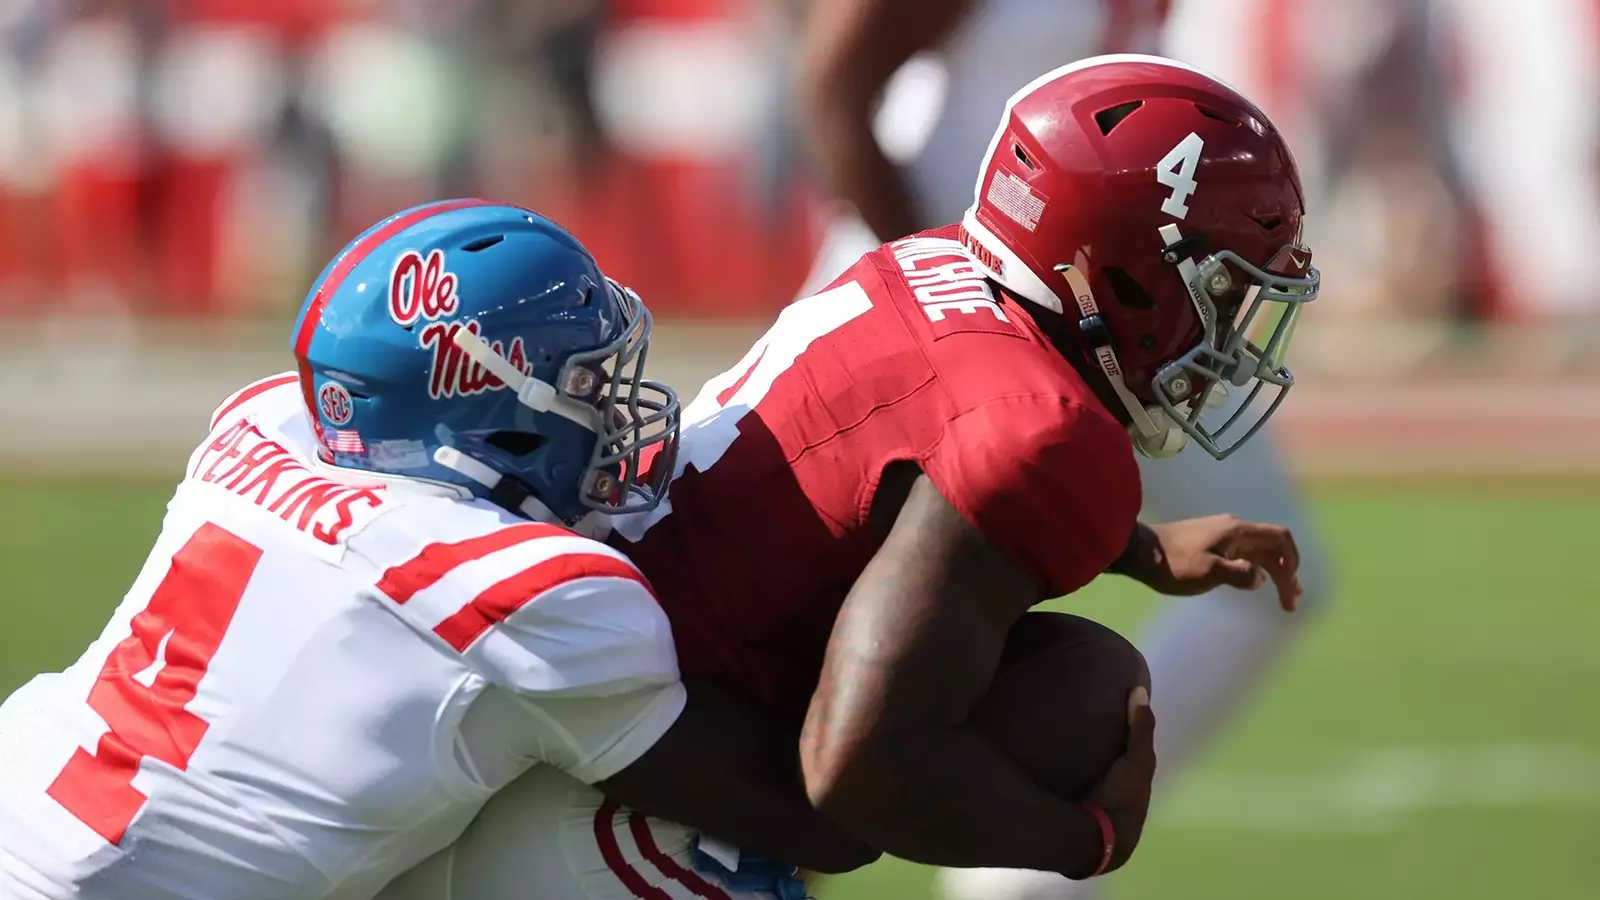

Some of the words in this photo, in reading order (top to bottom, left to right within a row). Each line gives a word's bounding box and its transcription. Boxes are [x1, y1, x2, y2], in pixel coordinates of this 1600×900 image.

[1157, 131, 1204, 219] 4
[389, 249, 459, 325] Ole
[969, 235, 1003, 276] TIDE
[1101, 350, 1121, 376] TIDE
[320, 385, 350, 422] SEC
[192, 418, 386, 545] PERKINS
[46, 521, 263, 845] 4
